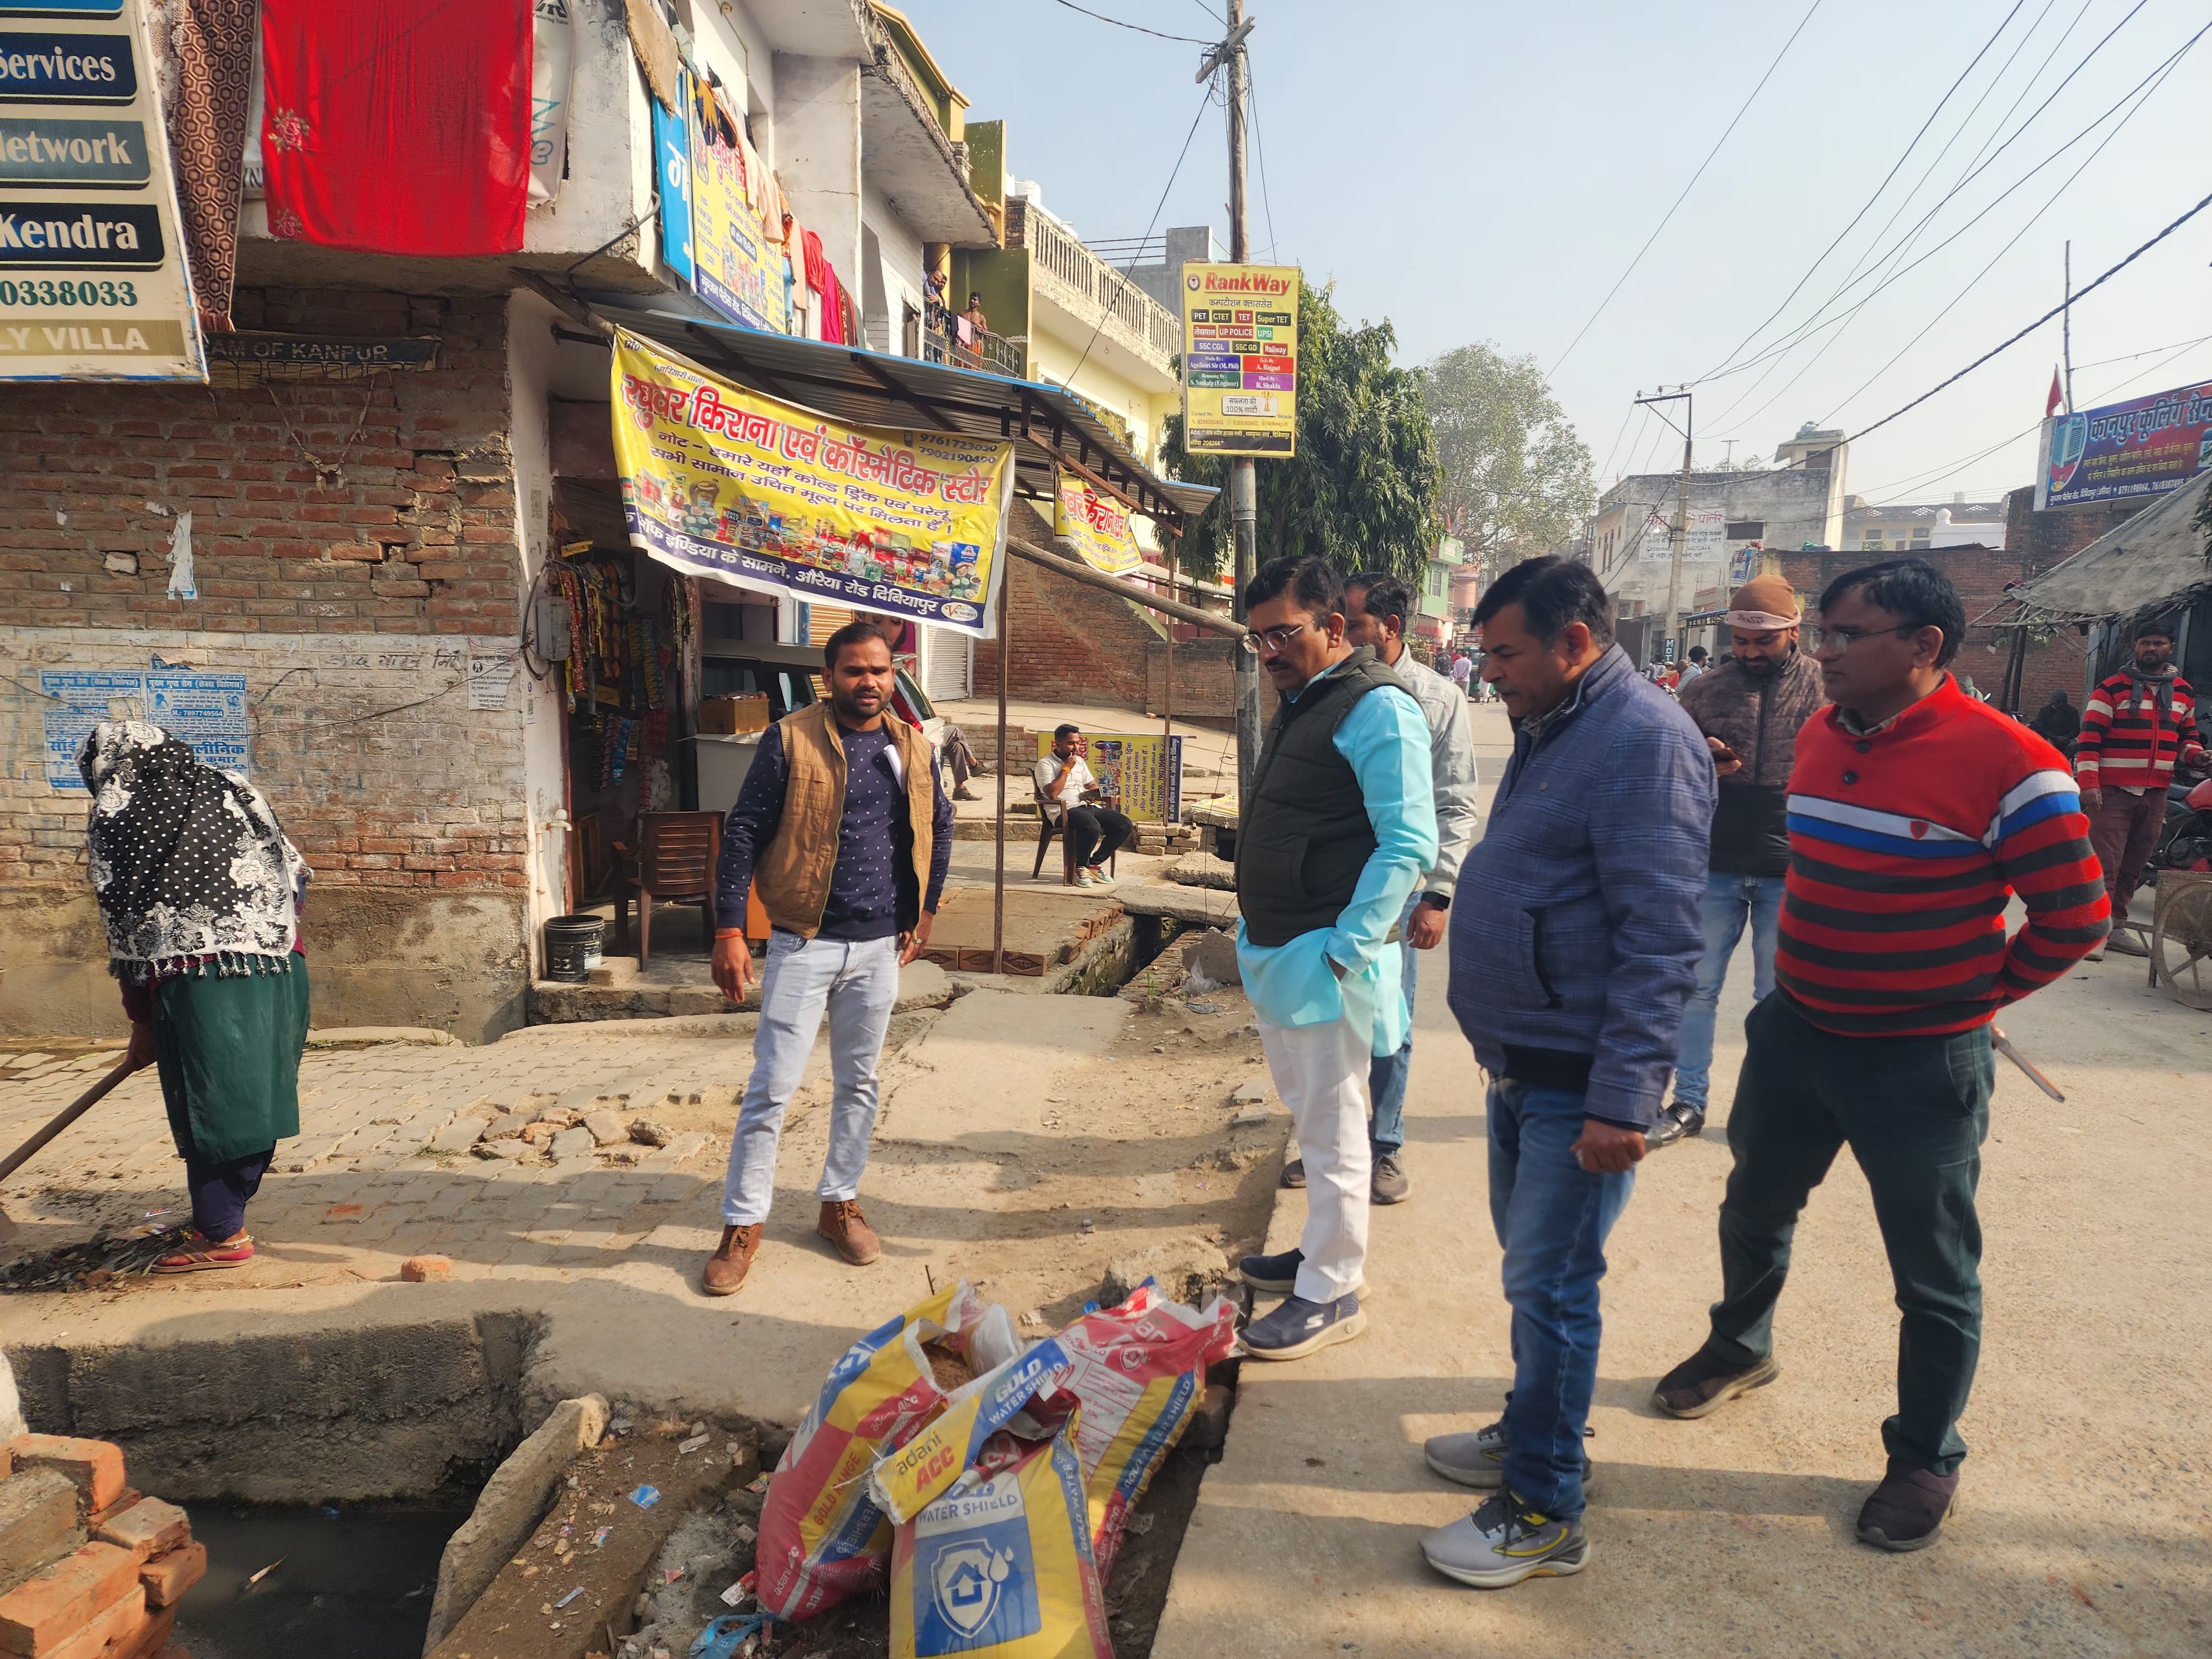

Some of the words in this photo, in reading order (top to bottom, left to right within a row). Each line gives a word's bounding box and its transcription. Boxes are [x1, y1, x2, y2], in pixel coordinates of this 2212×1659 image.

[0, 213, 139, 251] Kendra
[1193, 326, 1216, 336] लेखपाल
[1213, 312, 1229, 321] CTET
[1229, 328, 1253, 336] POLICE
[1257, 315, 1275, 324] Super
[41, 327, 149, 351] VILLA
[1257, 329, 1272, 337] UPSI
[252, 342, 284, 358] OF
[291, 342, 387, 361] KANPUR
[1265, 345, 1287, 355] Railway
[1249, 397, 1256, 405] की
[687, 384, 781, 452] किराना
[780, 424, 827, 465] एवं
[822, 434, 940, 496] कॉस्मेटिक
[920, 433, 998, 452] 9761723030
[2090, 412, 2137, 445] कानपुर
[650, 446, 687, 465] सभी
[691, 457, 747, 481] सामान
[750, 474, 796, 494] उचित
[801, 488, 838, 505] मूल्य
[843, 499, 866, 514] पर
[869, 507, 922, 528] मिलता
[658, 431, 688, 448] नोट
[708, 445, 754, 467] हमारे
[757, 460, 793, 478] यहाँ
[794, 473, 839, 493] कोल्ड
[843, 484, 880, 502] ड्रिंक
[884, 497, 910, 510] एवं
[912, 505, 952, 522] घरेलू
[665, 531, 718, 560] इण्डिया
[721, 548, 739, 564] के
[795, 568, 841, 591] औरैया
[844, 579, 870, 598] रोड
[872, 585, 939, 615] दिबियापुर
[205, 756, 238, 765] कुमार
[988, 1393, 1025, 1426] WATER
[1025, 1362, 1063, 1390] SHIELD
[995, 1358, 1041, 1404] GOLD
[1166, 1380, 1191, 1420] SHIELD
[896, 1431, 942, 1476] adani
[916, 1445, 955, 1494] ACC
[1065, 1463, 1081, 1509] WATER
[813, 1495, 837, 1526] GOLD
[918, 1504, 958, 1522] WATER
[962, 1494, 1018, 1515] SHIELD
[1073, 1514, 1088, 1552] GOLD
